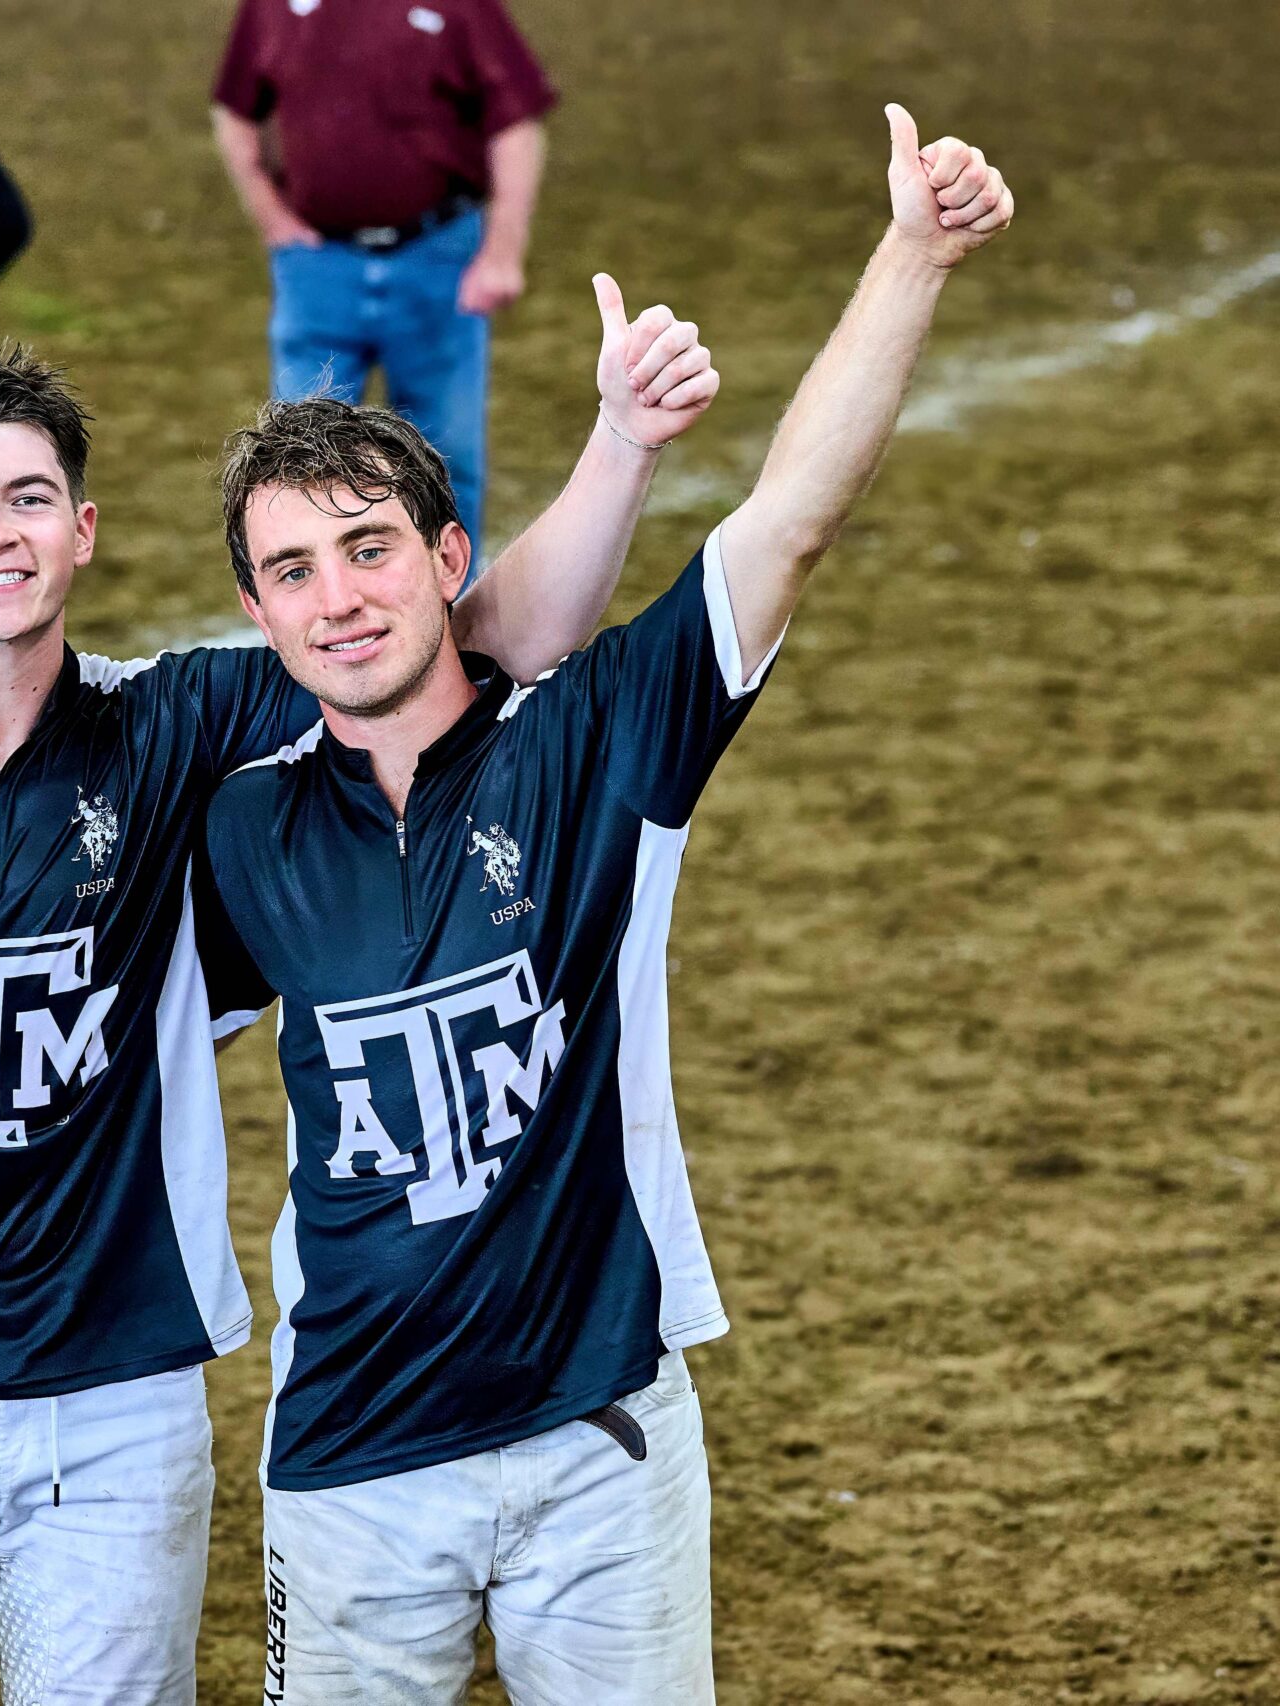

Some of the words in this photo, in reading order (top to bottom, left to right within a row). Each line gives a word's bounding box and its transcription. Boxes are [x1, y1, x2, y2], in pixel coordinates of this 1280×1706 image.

[75, 877, 115, 898] USPA
[490, 896, 536, 925] USPA
[264, 1543, 287, 1706] LIBERTY
